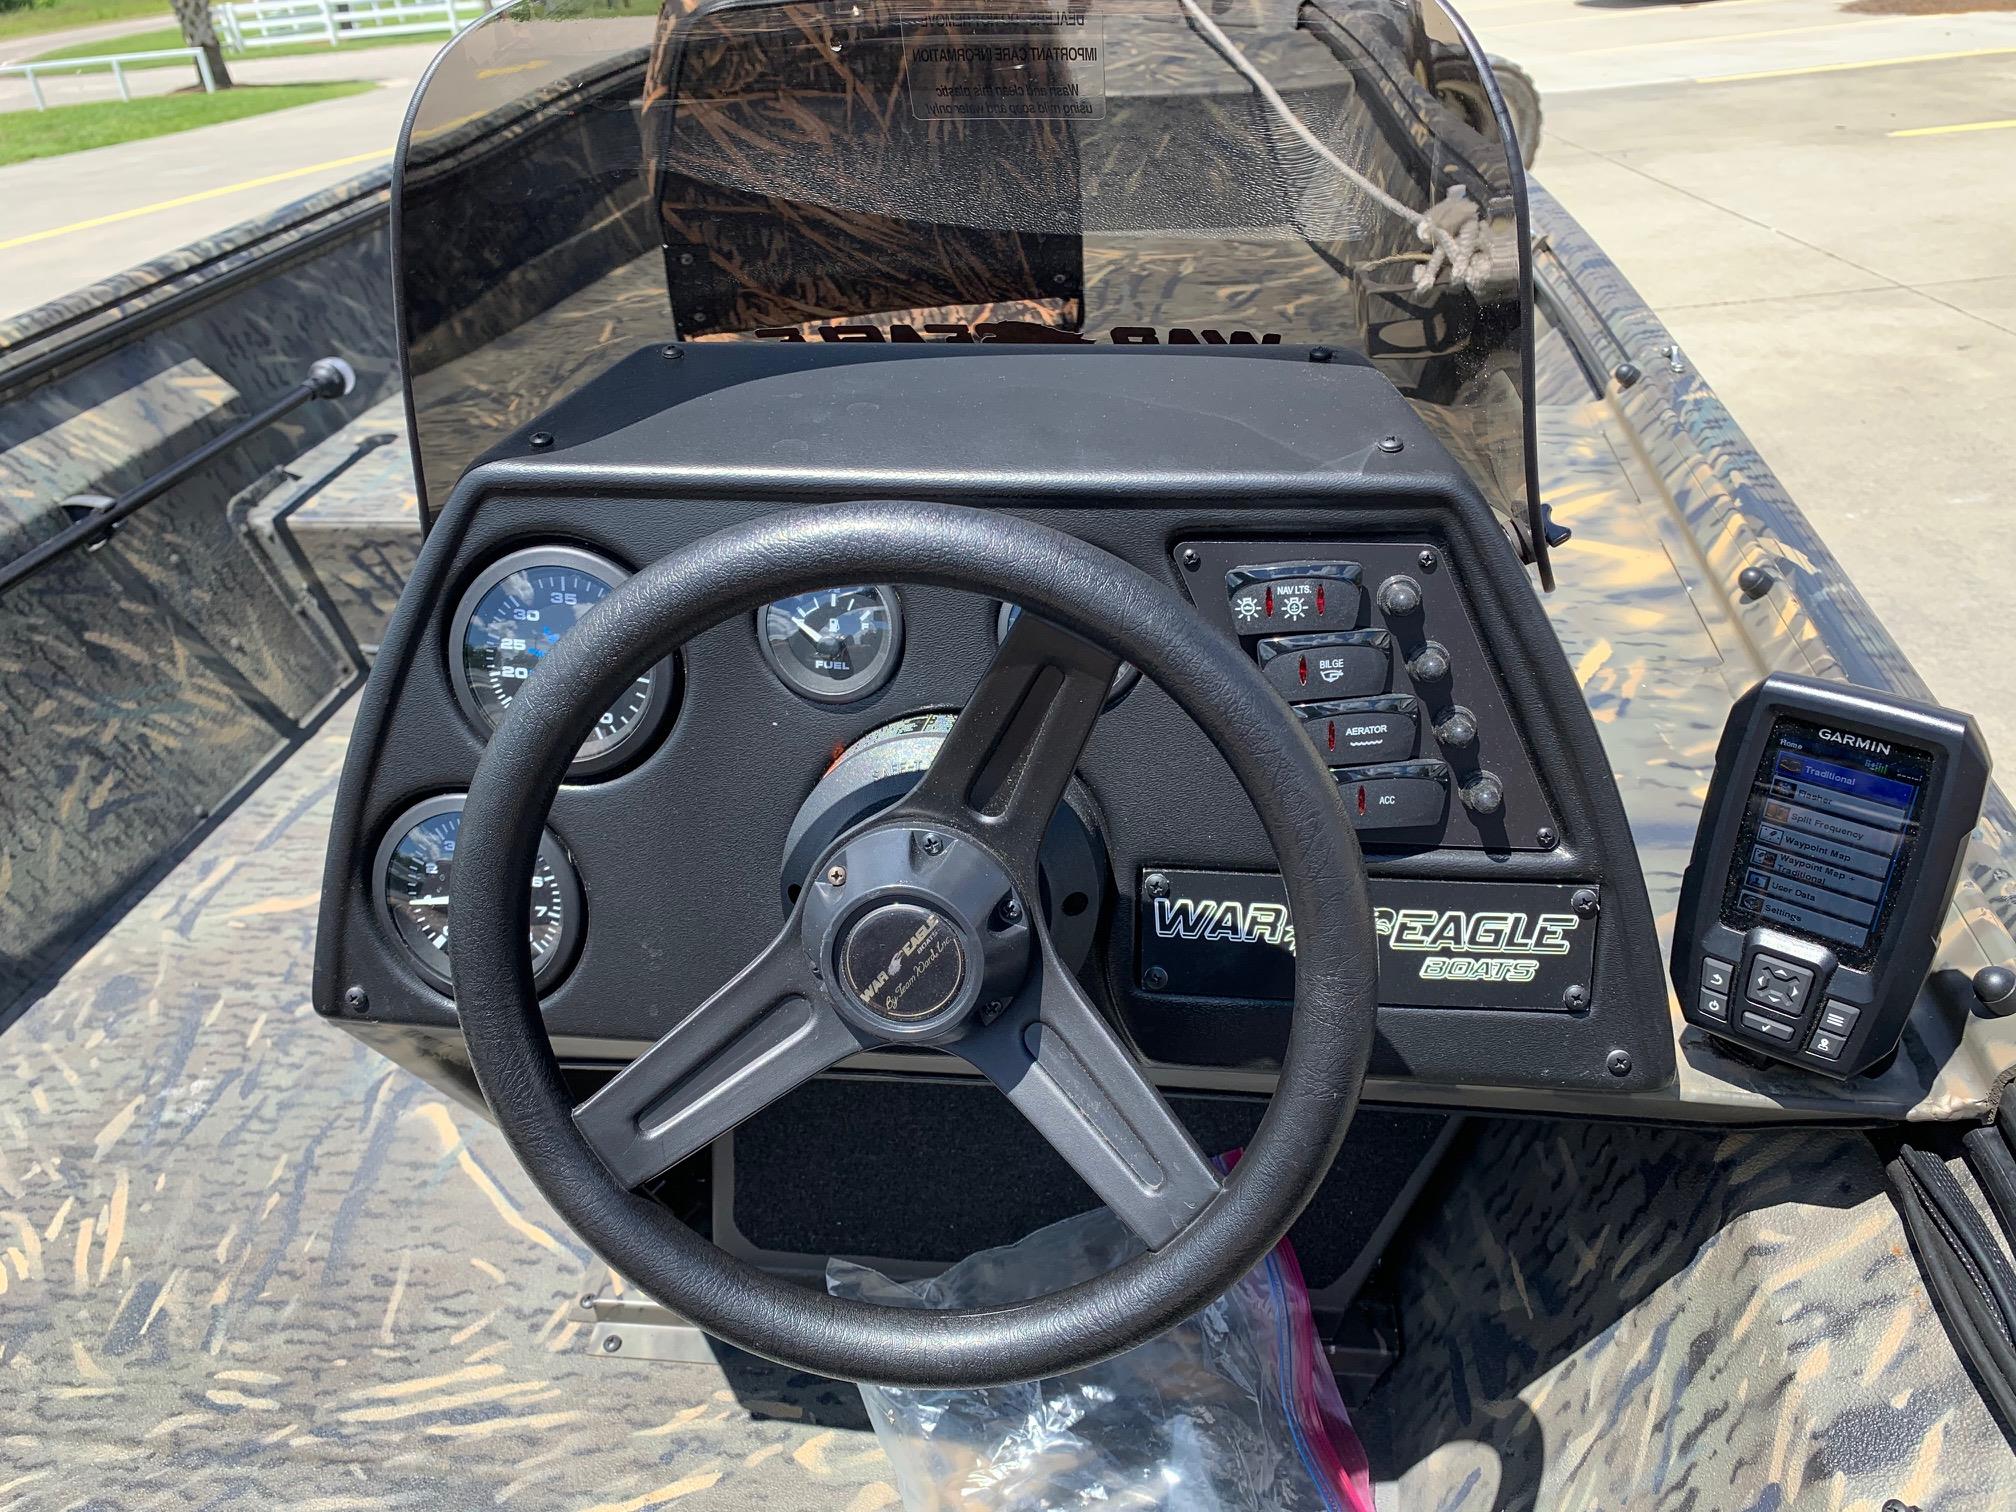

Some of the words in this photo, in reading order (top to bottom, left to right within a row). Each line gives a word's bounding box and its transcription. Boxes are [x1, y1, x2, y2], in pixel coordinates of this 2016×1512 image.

[1276, 585, 1294, 596] NAV
[550, 592, 577, 605] 35
[513, 609, 540, 622] 30
[500, 639, 527, 651] 25
[815, 660, 850, 670] FUEL
[1319, 658, 1344, 670] BILGE
[501, 666, 528, 679] 20
[1345, 724, 1388, 737] AERATOR
[1780, 738, 1803, 750] Home
[1818, 728, 1892, 756] GARMIN
[1805, 765, 1857, 787] Traditional
[1379, 795, 1396, 806] ACC
[1791, 812, 1813, 826] Split
[1814, 819, 1865, 841] Frequency
[1785, 835, 1829, 856] Waypoint
[1830, 848, 1852, 863] Map
[425, 863, 438, 874] 2
[1780, 853, 1823, 873] Waypoint
[1824, 866, 1847, 881] Map
[532, 875, 543, 888] 6
[1771, 881, 1793, 895] User
[1794, 889, 1817, 903] Data
[534, 906, 548, 917] 7
[1765, 904, 1802, 922] Settings
[1154, 898, 1285, 944] WAR
[1389, 909, 1580, 956] EAGLE
[1418, 957, 1540, 982] BOATS
[859, 971, 889, 1003] WAR
